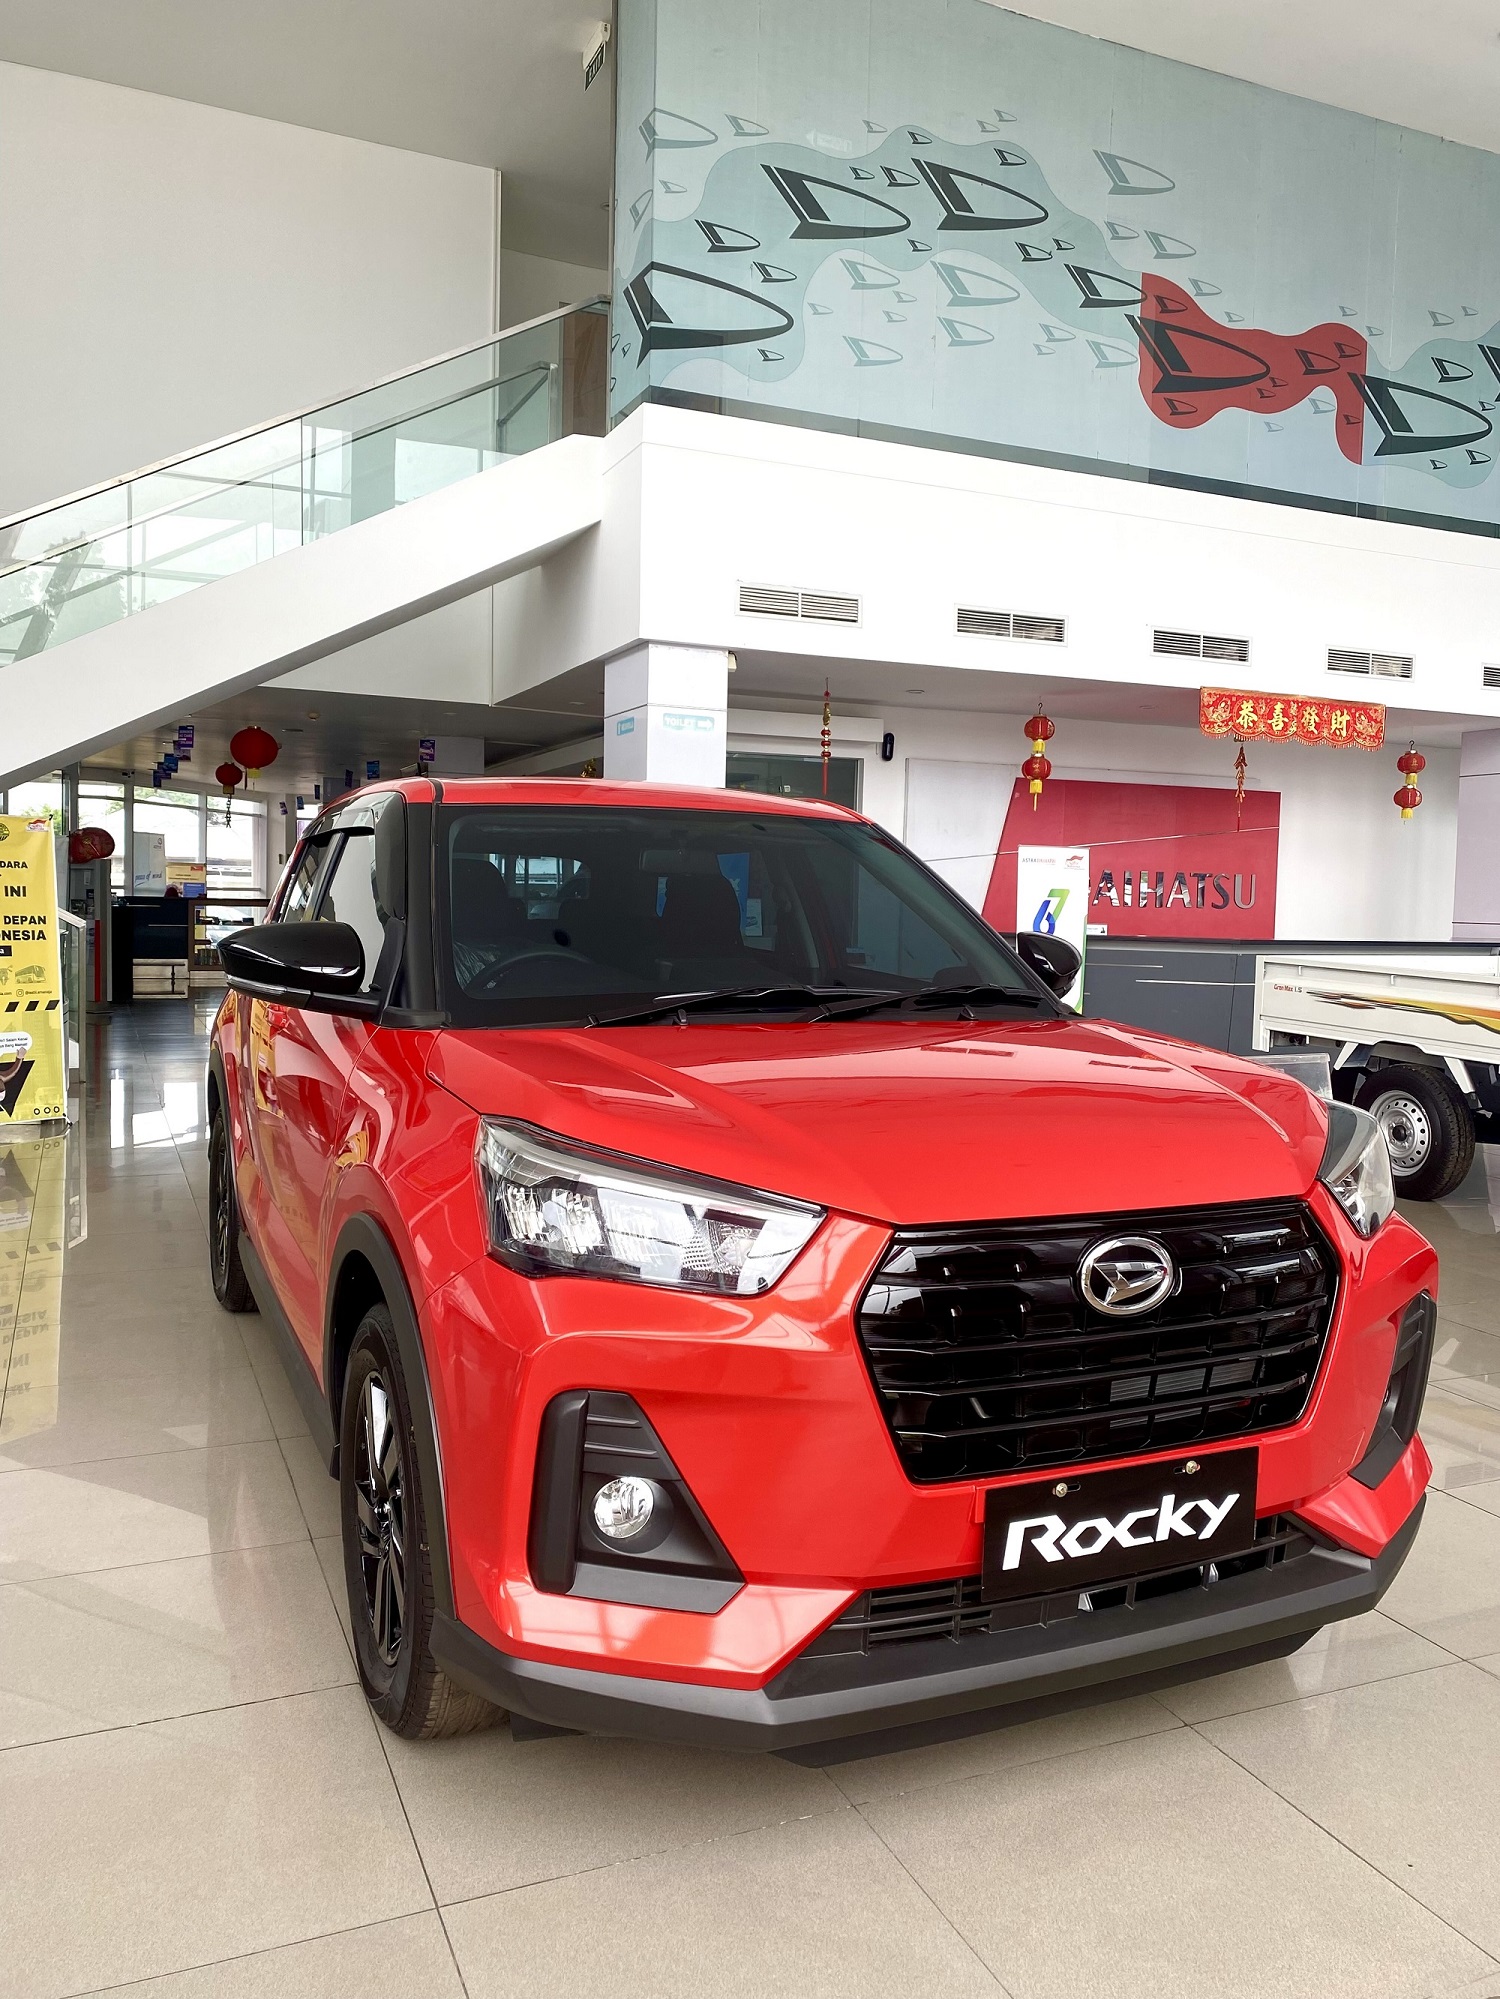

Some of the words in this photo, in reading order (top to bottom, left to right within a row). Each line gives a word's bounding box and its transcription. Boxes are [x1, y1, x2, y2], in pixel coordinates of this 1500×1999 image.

[1235, 699, 1350, 738] 恭喜發財
[4, 885, 27, 897] INI
[1088, 869, 1256, 910] AIHATSU
[3, 915, 47, 925] DEPAN
[0, 930, 47, 941] NESIA
